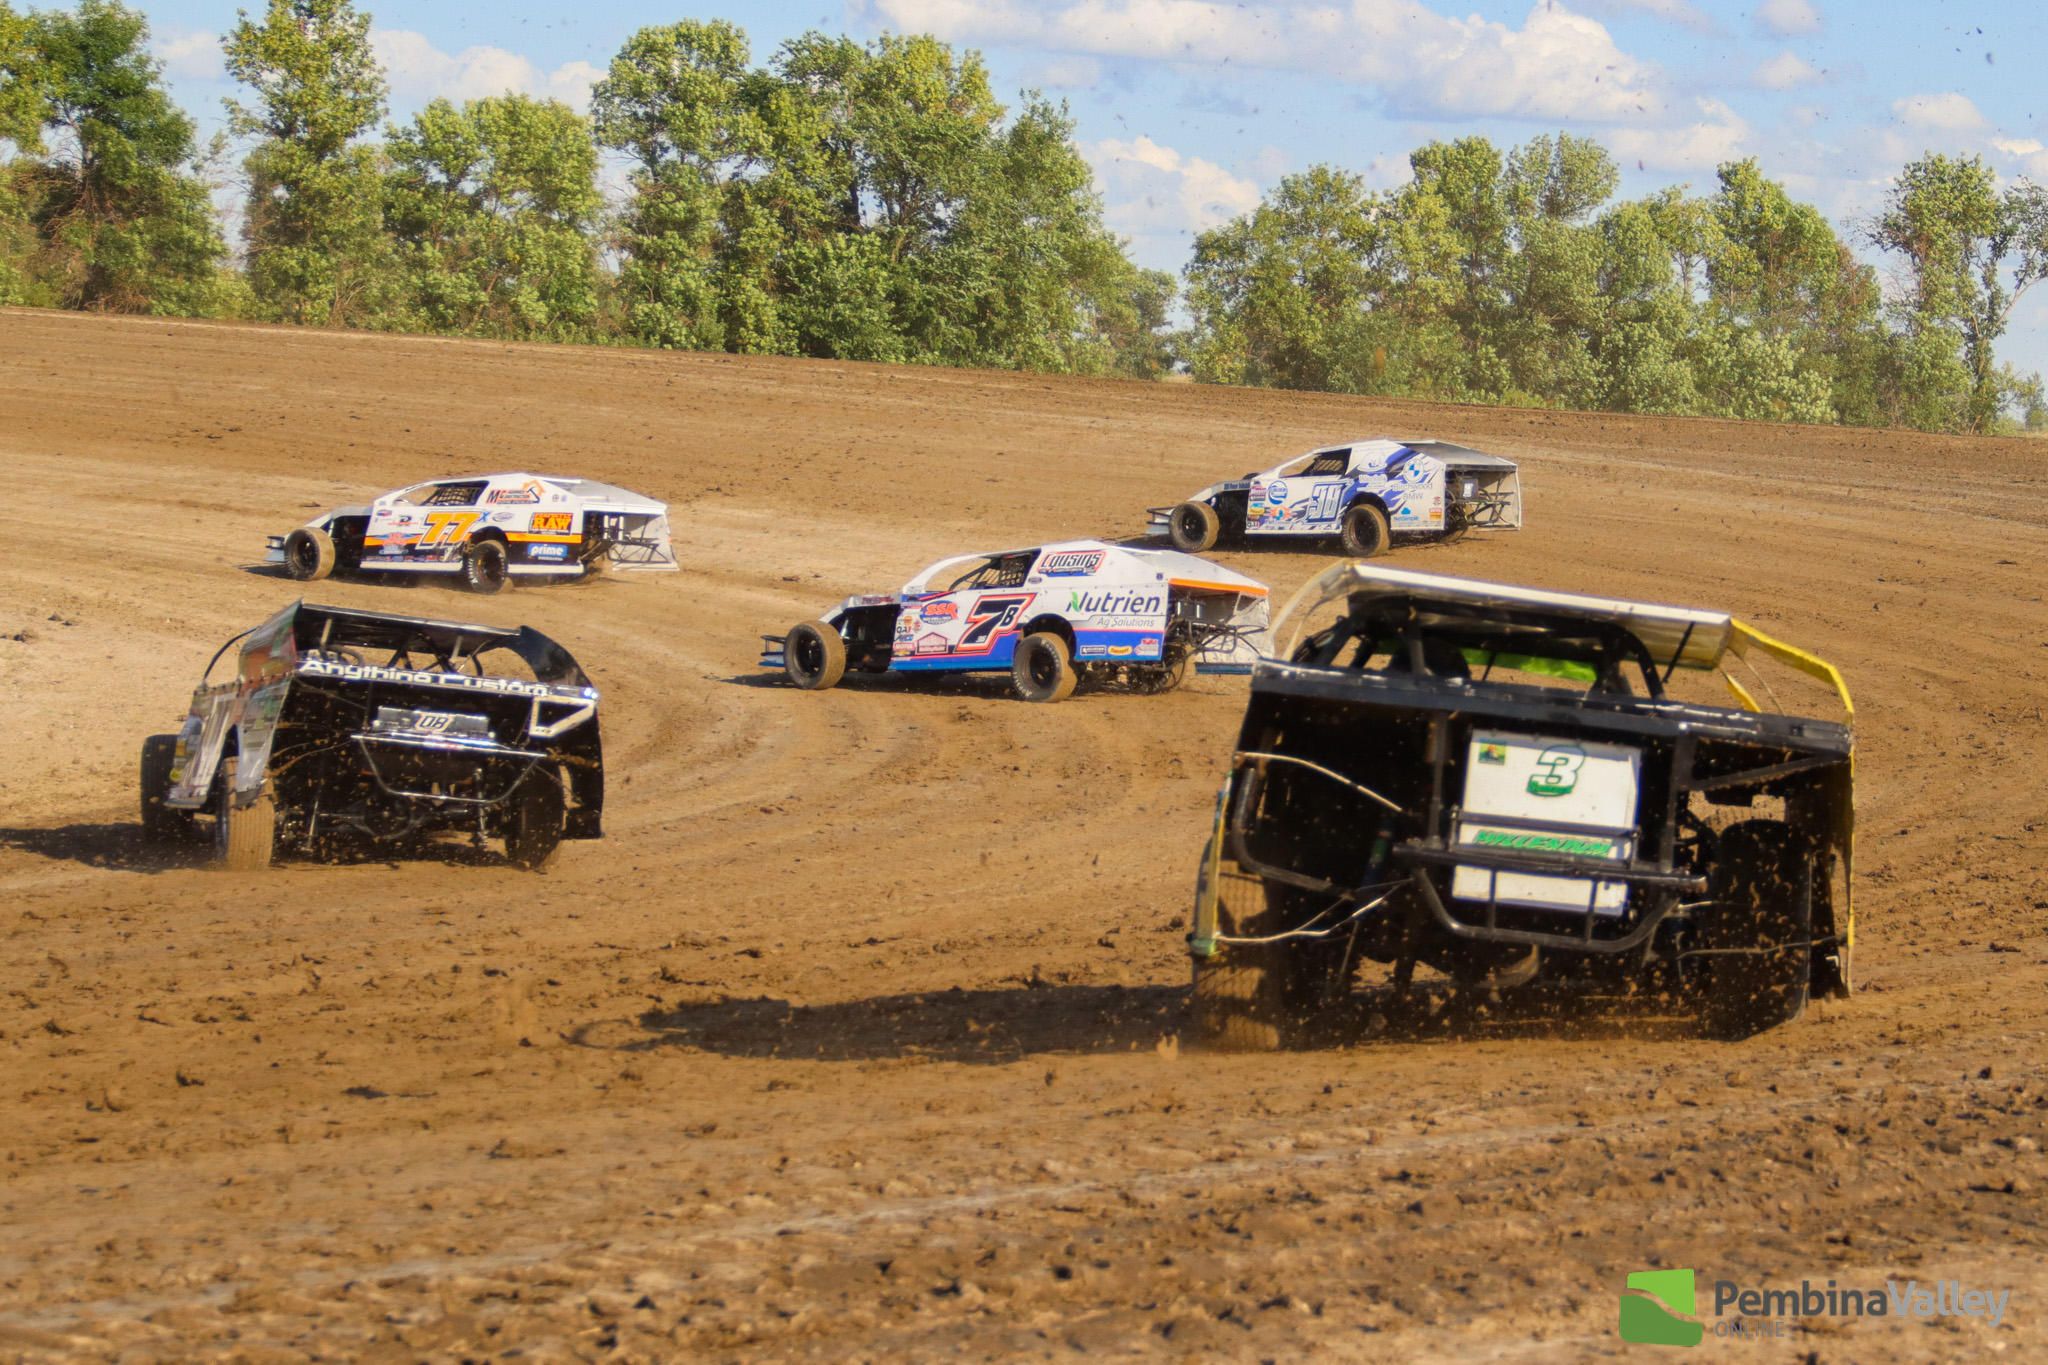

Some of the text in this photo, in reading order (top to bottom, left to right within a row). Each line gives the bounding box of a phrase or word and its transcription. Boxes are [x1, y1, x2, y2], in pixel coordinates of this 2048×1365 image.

[1393, 482, 1433, 491] Birchwood
[1402, 492, 1424, 501] BMW
[415, 509, 483, 549] 77
[532, 517, 572, 531] RAW
[531, 544, 564, 556] prime
[1065, 590, 1161, 613] Nutrien
[924, 602, 959, 620] SSR
[1097, 617, 1155, 628] Ag Solutions
[439, 674, 548, 697] Custom
[1526, 744, 1587, 798] 3
[1474, 829, 1613, 858] MILLENIUM
